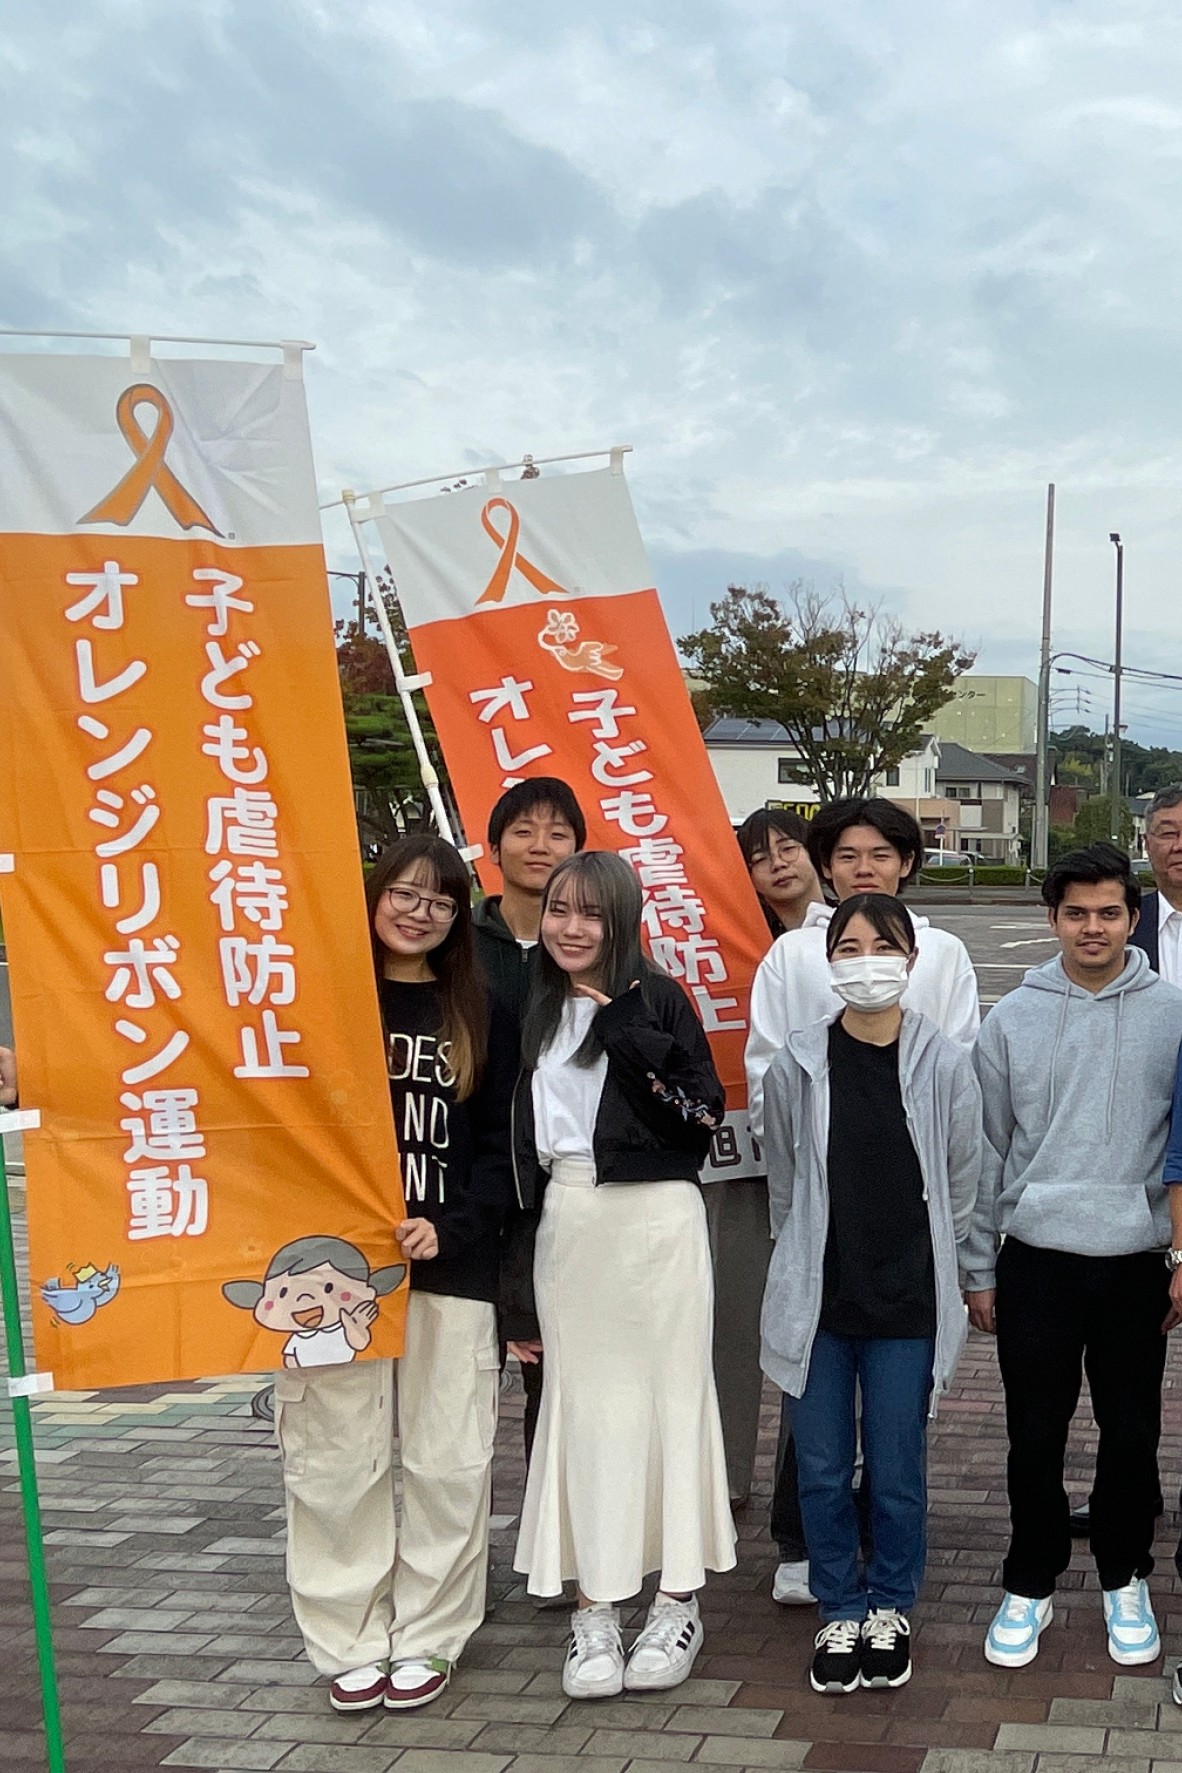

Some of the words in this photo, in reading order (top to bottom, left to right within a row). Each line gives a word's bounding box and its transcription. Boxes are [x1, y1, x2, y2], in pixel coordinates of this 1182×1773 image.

[64, 560, 209, 1241] オレンジリボン運動
[185, 567, 310, 1080] 子ども虐待防止
[469, 675, 553, 789] オレ
